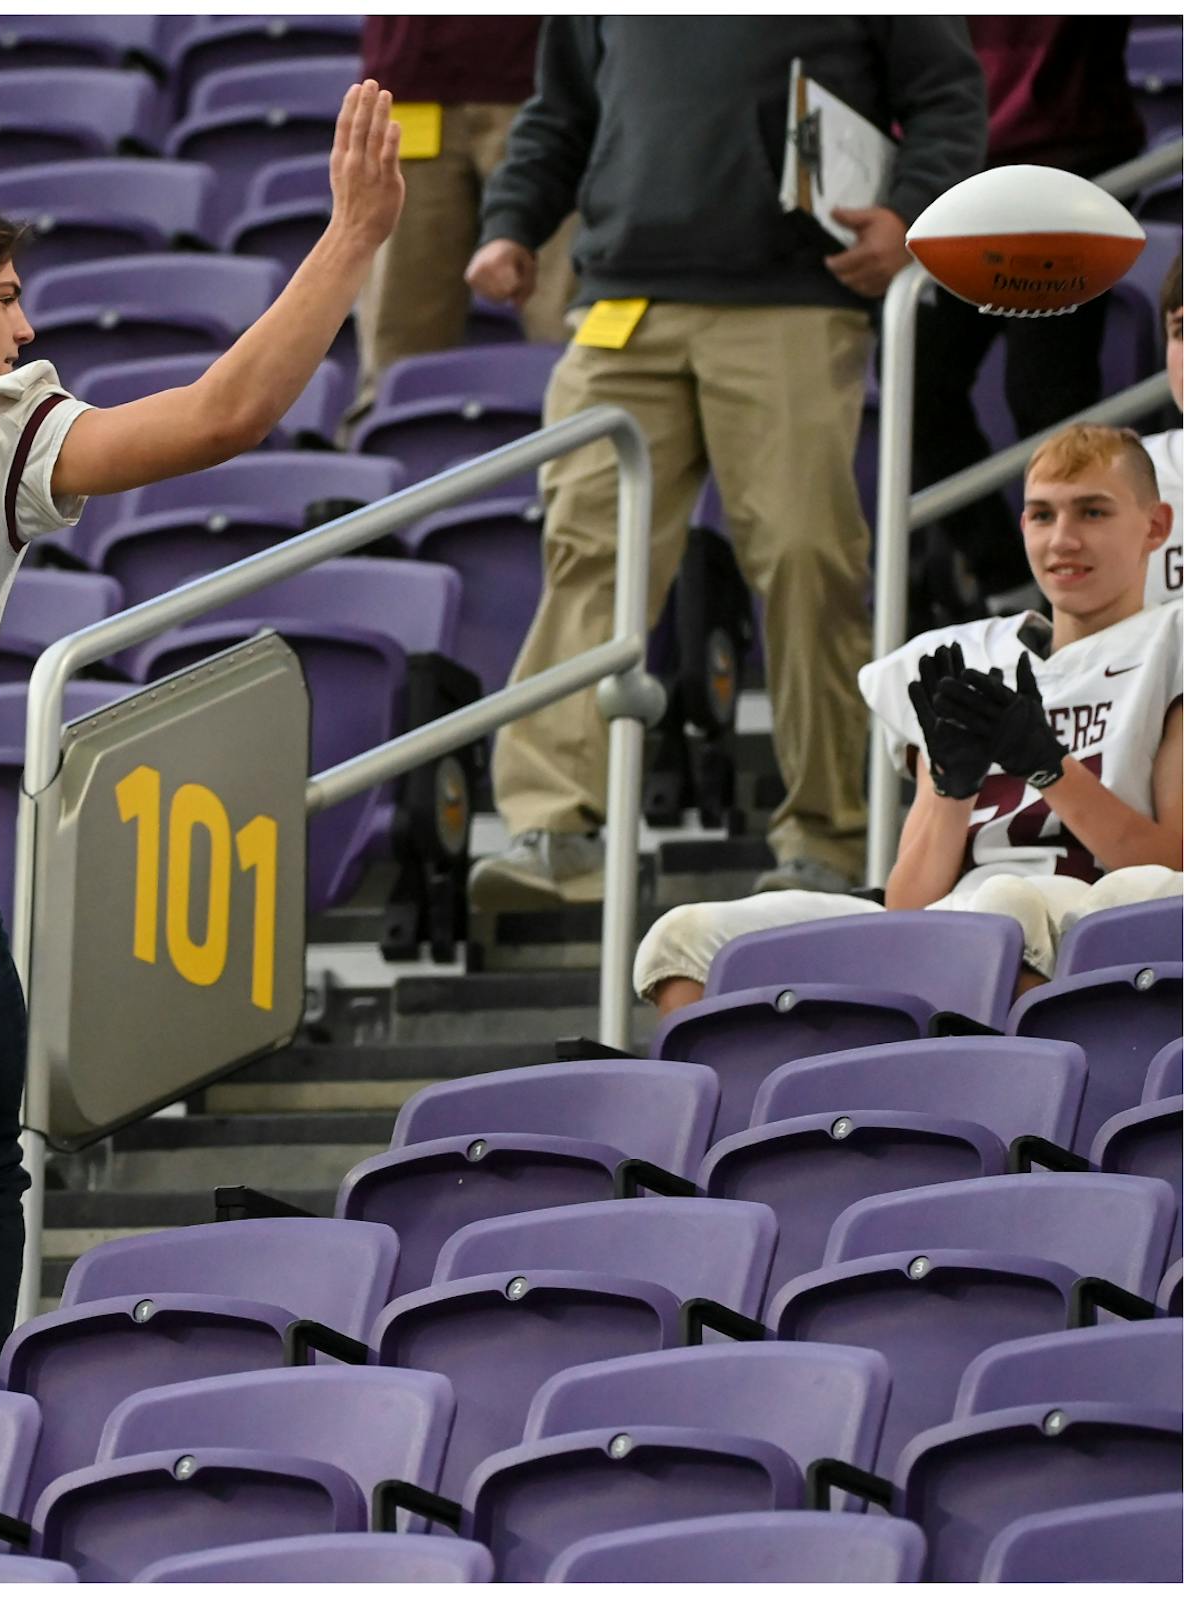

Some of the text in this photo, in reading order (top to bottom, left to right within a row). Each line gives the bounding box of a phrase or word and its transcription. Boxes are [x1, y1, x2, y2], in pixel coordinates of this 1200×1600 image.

[115, 765, 279, 1010] 101
[838, 1122, 847, 1133] 2
[914, 1261, 924, 1273] 3
[513, 1283, 522, 1294] 2
[1050, 1416, 1060, 1427] 4
[615, 1439, 625, 1451] 3
[180, 1461, 190, 1473] 2
